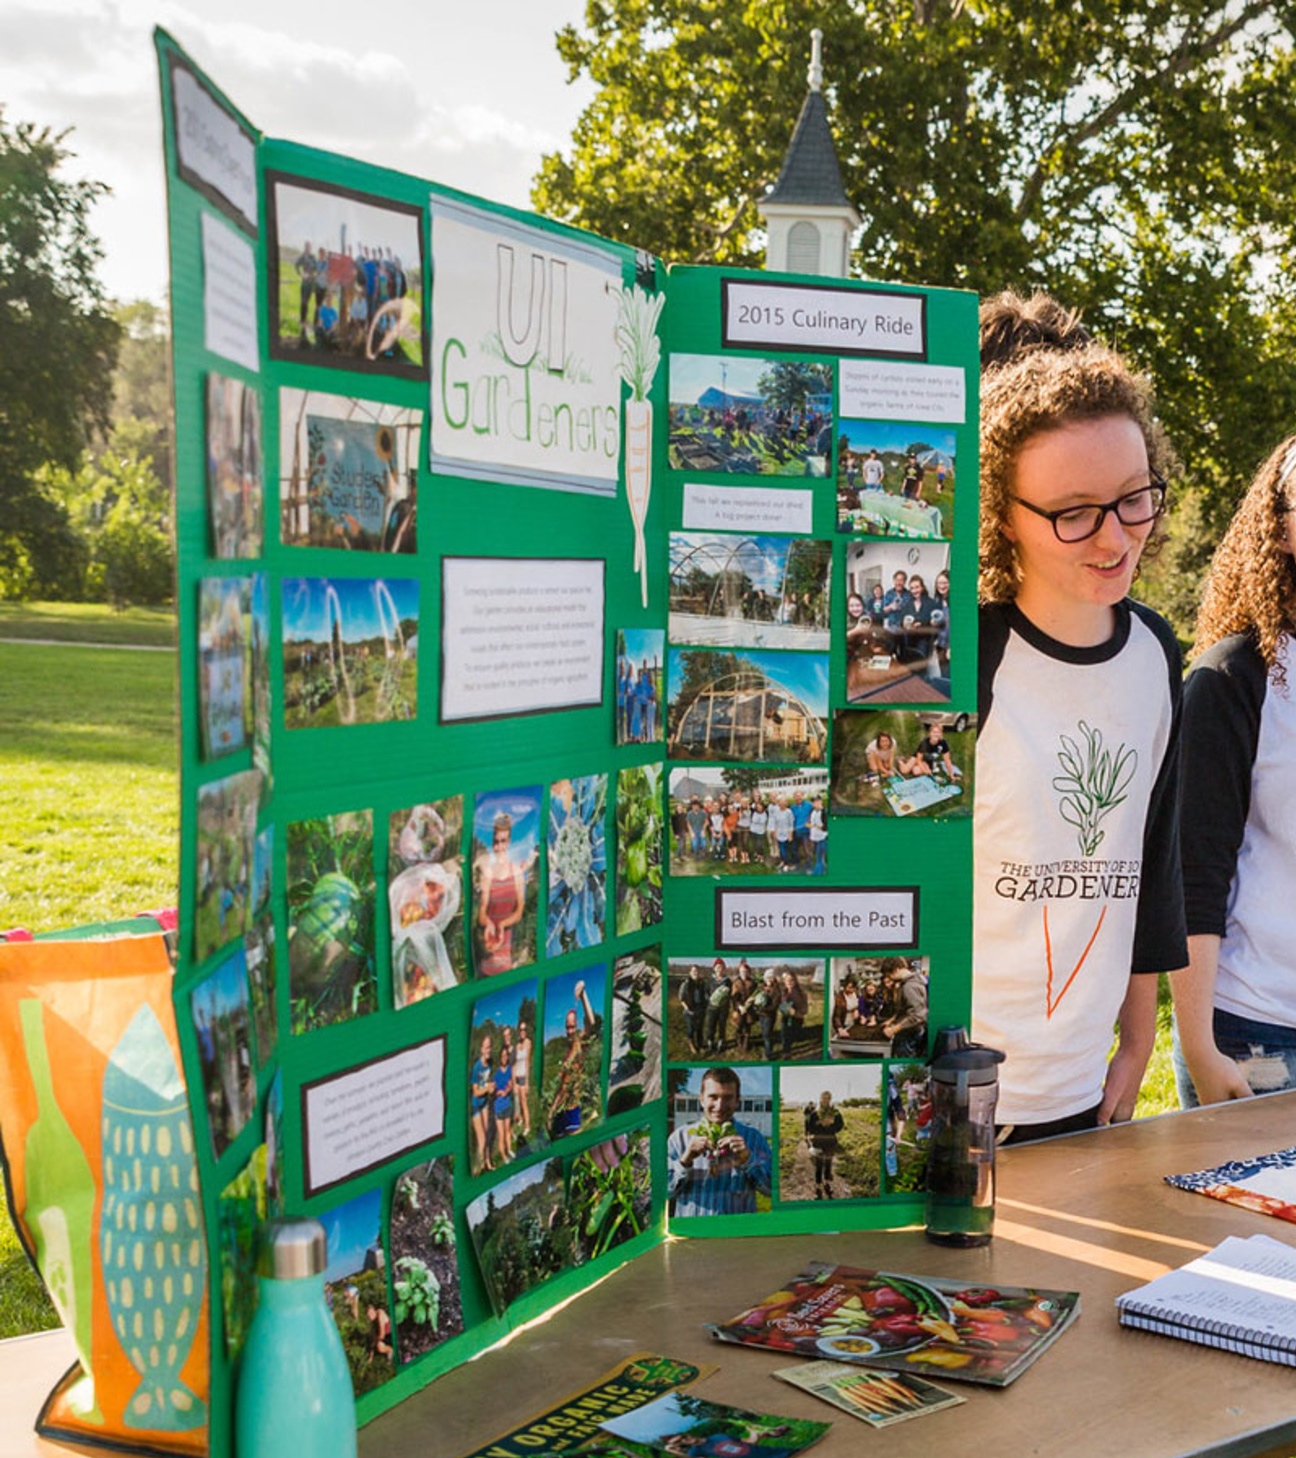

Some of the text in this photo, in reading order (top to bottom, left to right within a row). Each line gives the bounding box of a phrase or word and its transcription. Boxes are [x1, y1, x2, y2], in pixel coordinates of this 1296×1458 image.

[497, 243, 567, 376] UI
[738, 305, 914, 336] 2015 Culinary Ride
[441, 337, 619, 458] Gardeners
[1001, 861, 1033, 877] THE
[1110, 859, 1128, 873] OF
[731, 910, 906, 928] Blast from the Past
[513, 1384, 630, 1447] ORGANIC
[605, 1387, 657, 1416] MADE
